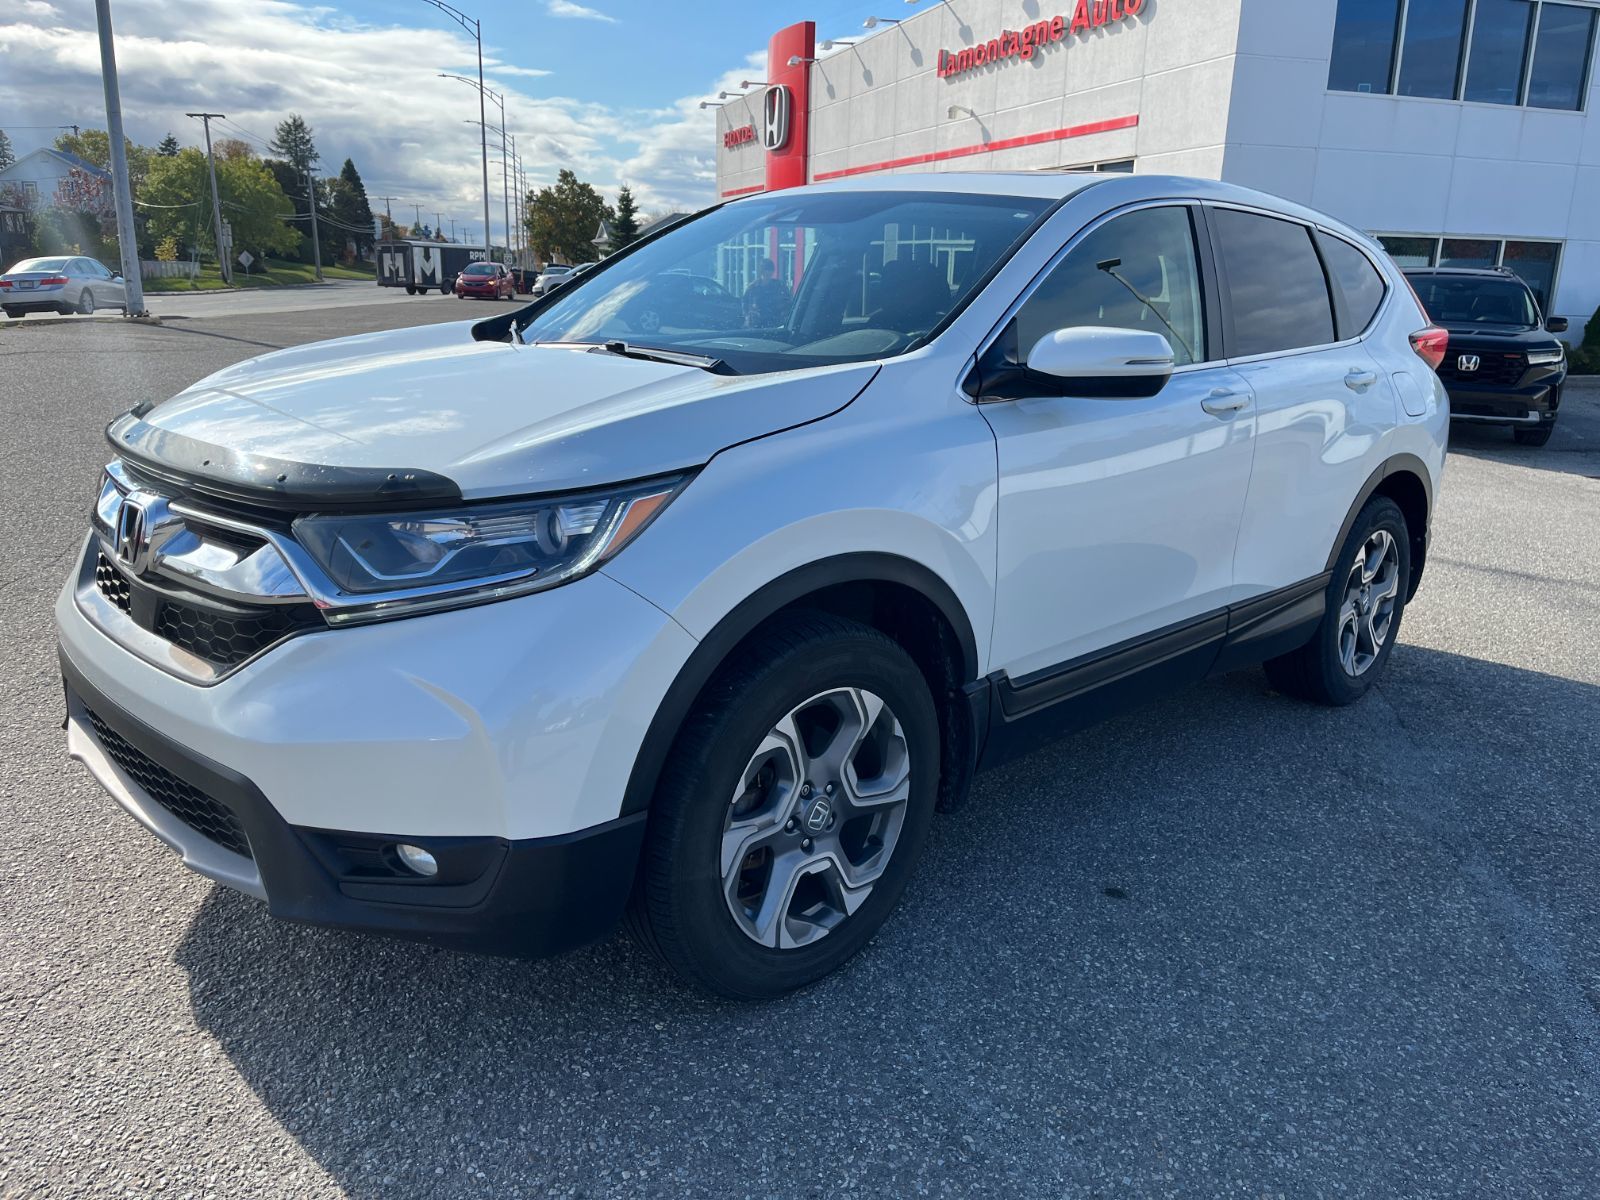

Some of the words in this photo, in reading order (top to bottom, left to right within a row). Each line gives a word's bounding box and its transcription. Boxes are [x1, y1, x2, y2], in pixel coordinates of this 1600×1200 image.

[937, 15, 1064, 78] Lamontagne
[1069, 0, 1142, 34] Auto
[723, 124, 753, 149] HONDA
[469, 250, 486, 260] RPM
